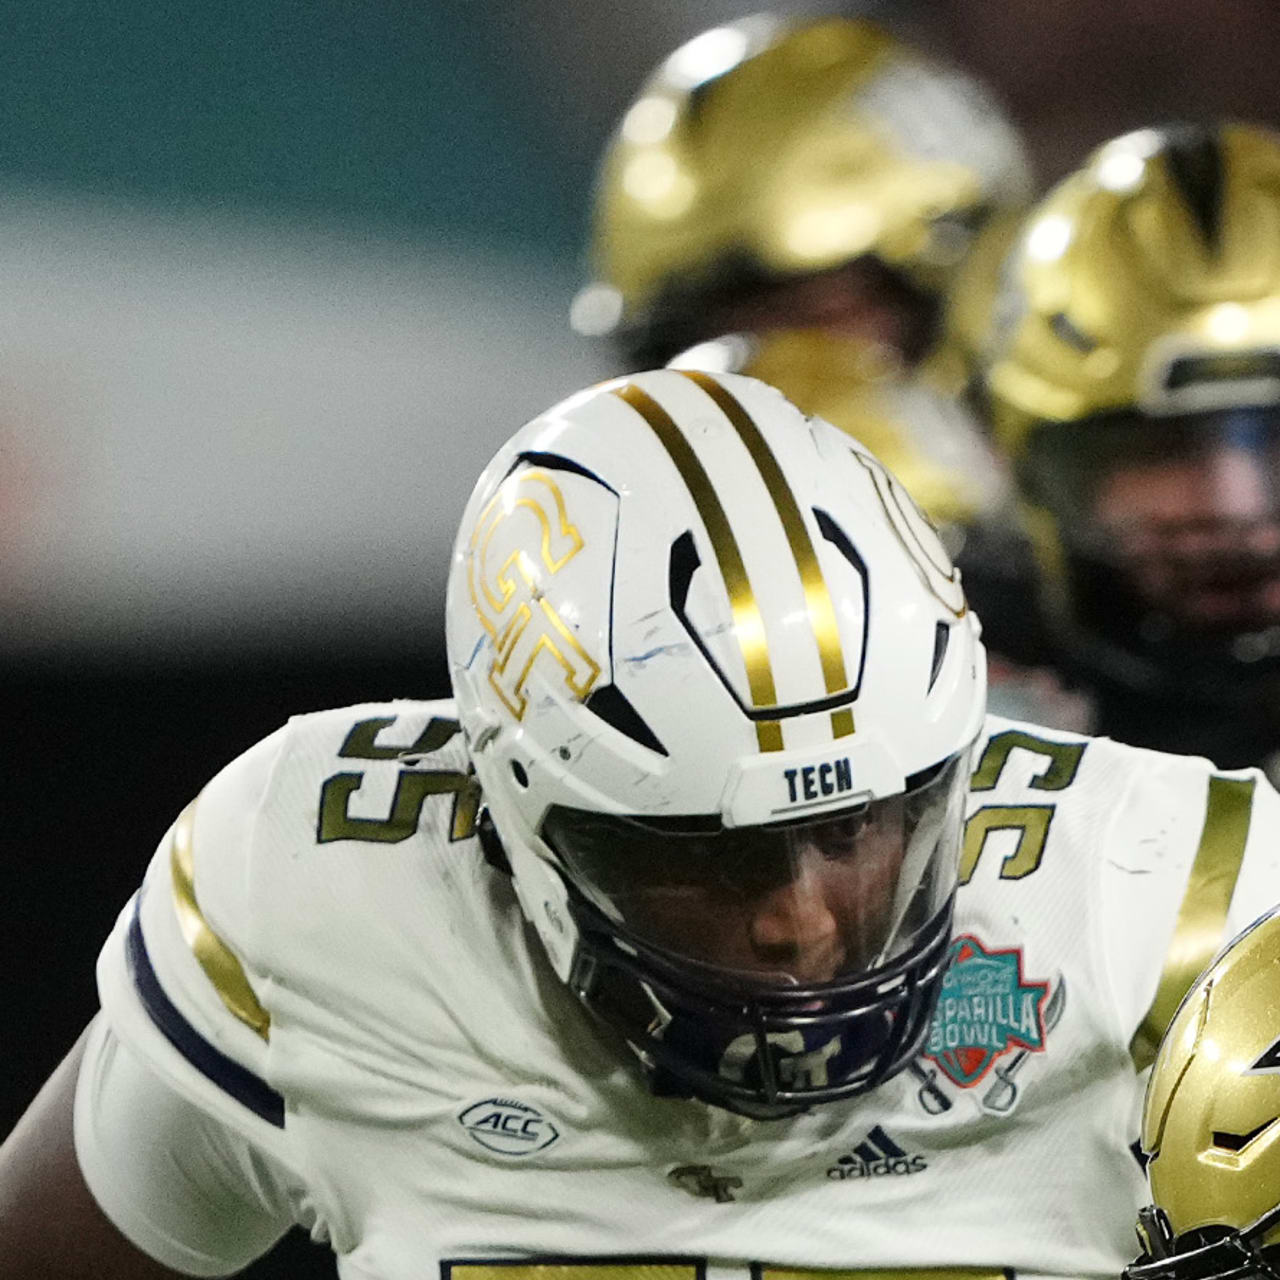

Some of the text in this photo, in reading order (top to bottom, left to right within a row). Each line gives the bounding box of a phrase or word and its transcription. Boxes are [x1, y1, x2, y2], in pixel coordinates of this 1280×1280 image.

[784, 756, 852, 803] TECH
[930, 1022, 1004, 1051] BOWL
[476, 1112, 546, 1138] ACC
[826, 1153, 929, 1181] adidas
